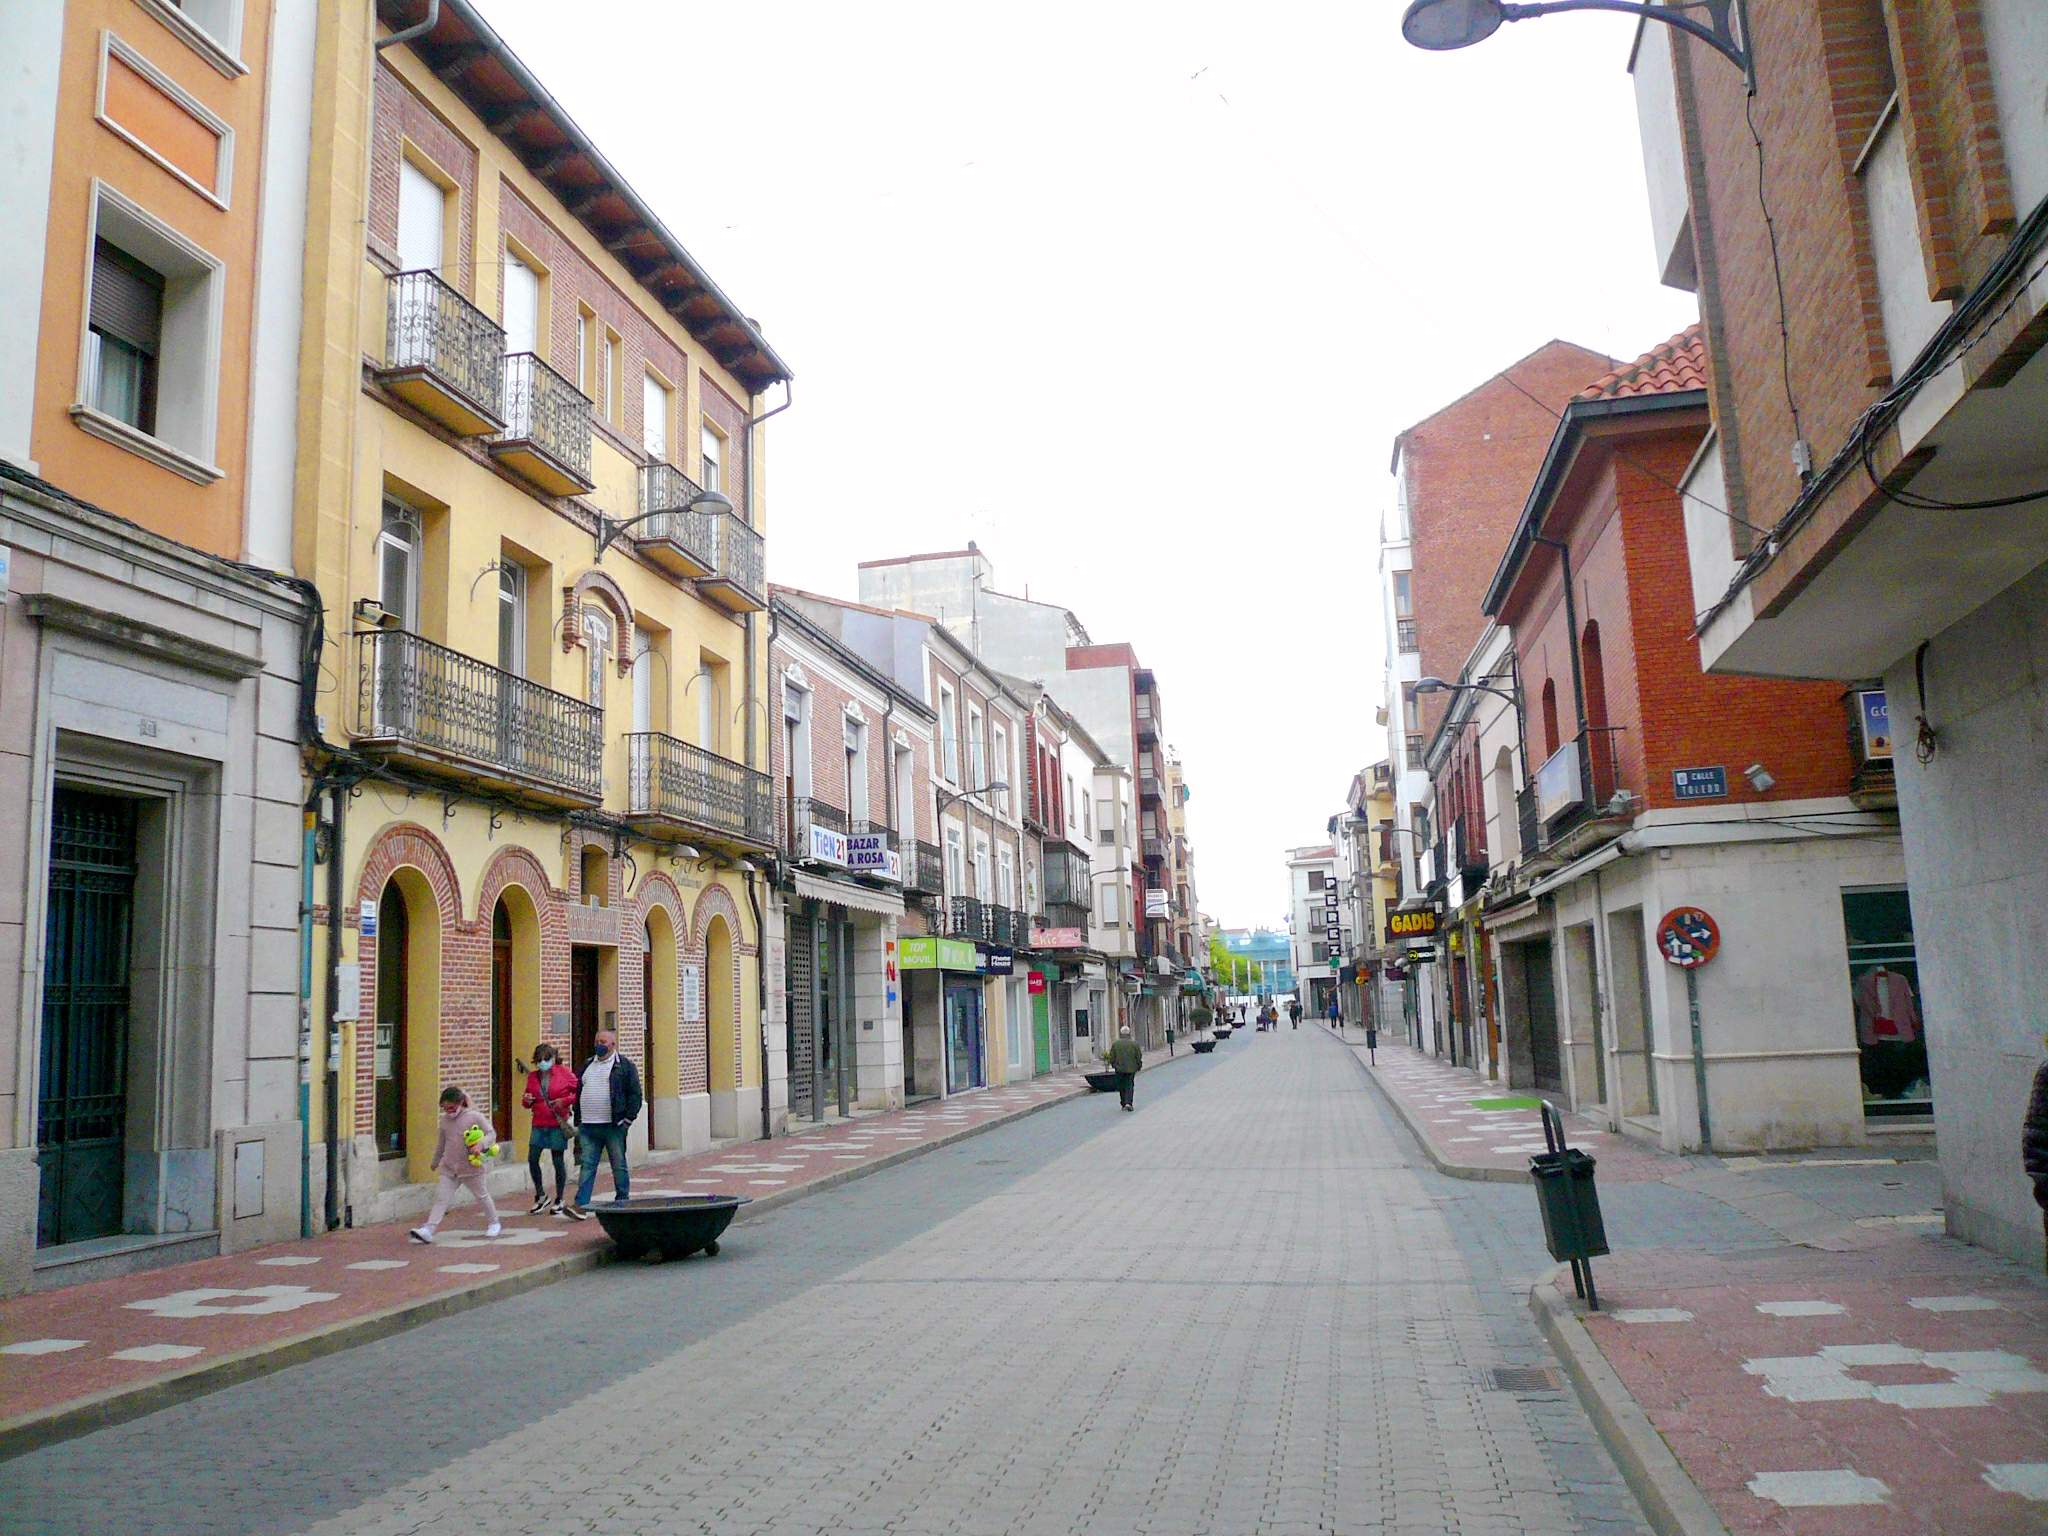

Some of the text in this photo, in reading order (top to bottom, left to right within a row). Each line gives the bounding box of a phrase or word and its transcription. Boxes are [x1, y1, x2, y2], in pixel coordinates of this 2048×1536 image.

[1691, 772, 1714, 780] CALLE
[1680, 784, 1720, 795] TOLEDO
[847, 838, 880, 850] BAZAR
[857, 852, 884, 864] ROSA
[1325, 879, 1340, 956] PEREZ
[1391, 912, 1435, 933] GADIS
